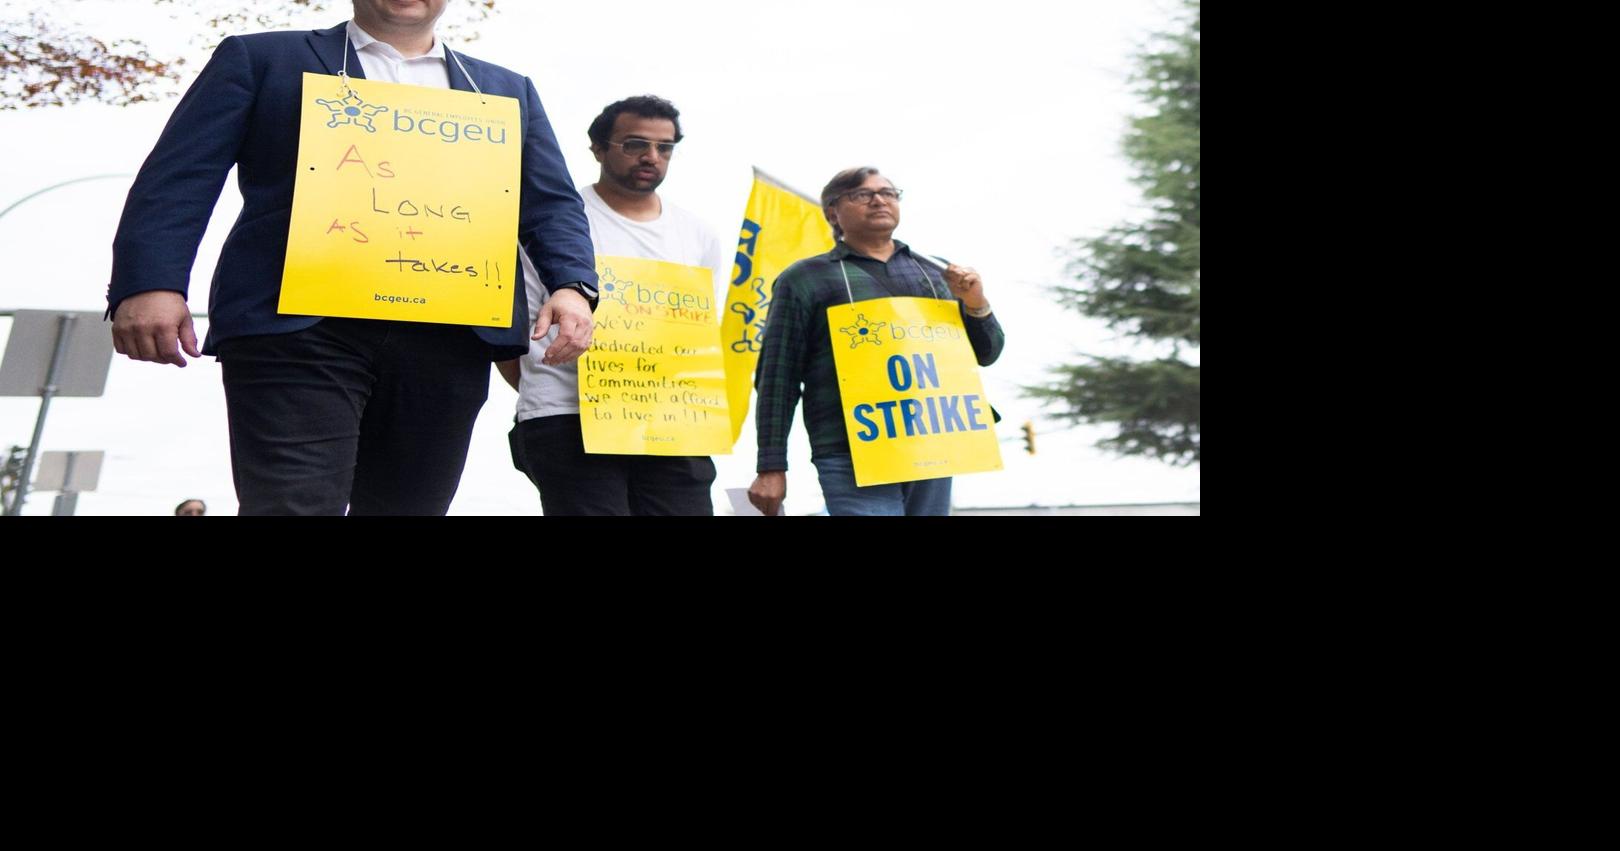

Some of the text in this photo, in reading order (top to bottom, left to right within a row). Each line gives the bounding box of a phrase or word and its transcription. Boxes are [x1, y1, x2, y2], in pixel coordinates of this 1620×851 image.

[393, 109, 506, 145] bcgeu
[336, 144, 395, 178] As
[372, 187, 471, 223] LONG
[326, 219, 424, 243] AS it
[374, 293, 426, 304] bcgeu.ca
[624, 303, 652, 315] ON
[636, 284, 710, 311] bcgeu
[890, 322, 961, 342] bcgeu
[585, 356, 658, 373] lives for
[886, 353, 940, 392] ON
[593, 407, 612, 421] to
[622, 407, 653, 421] live
[853, 395, 988, 442] STRIKE
